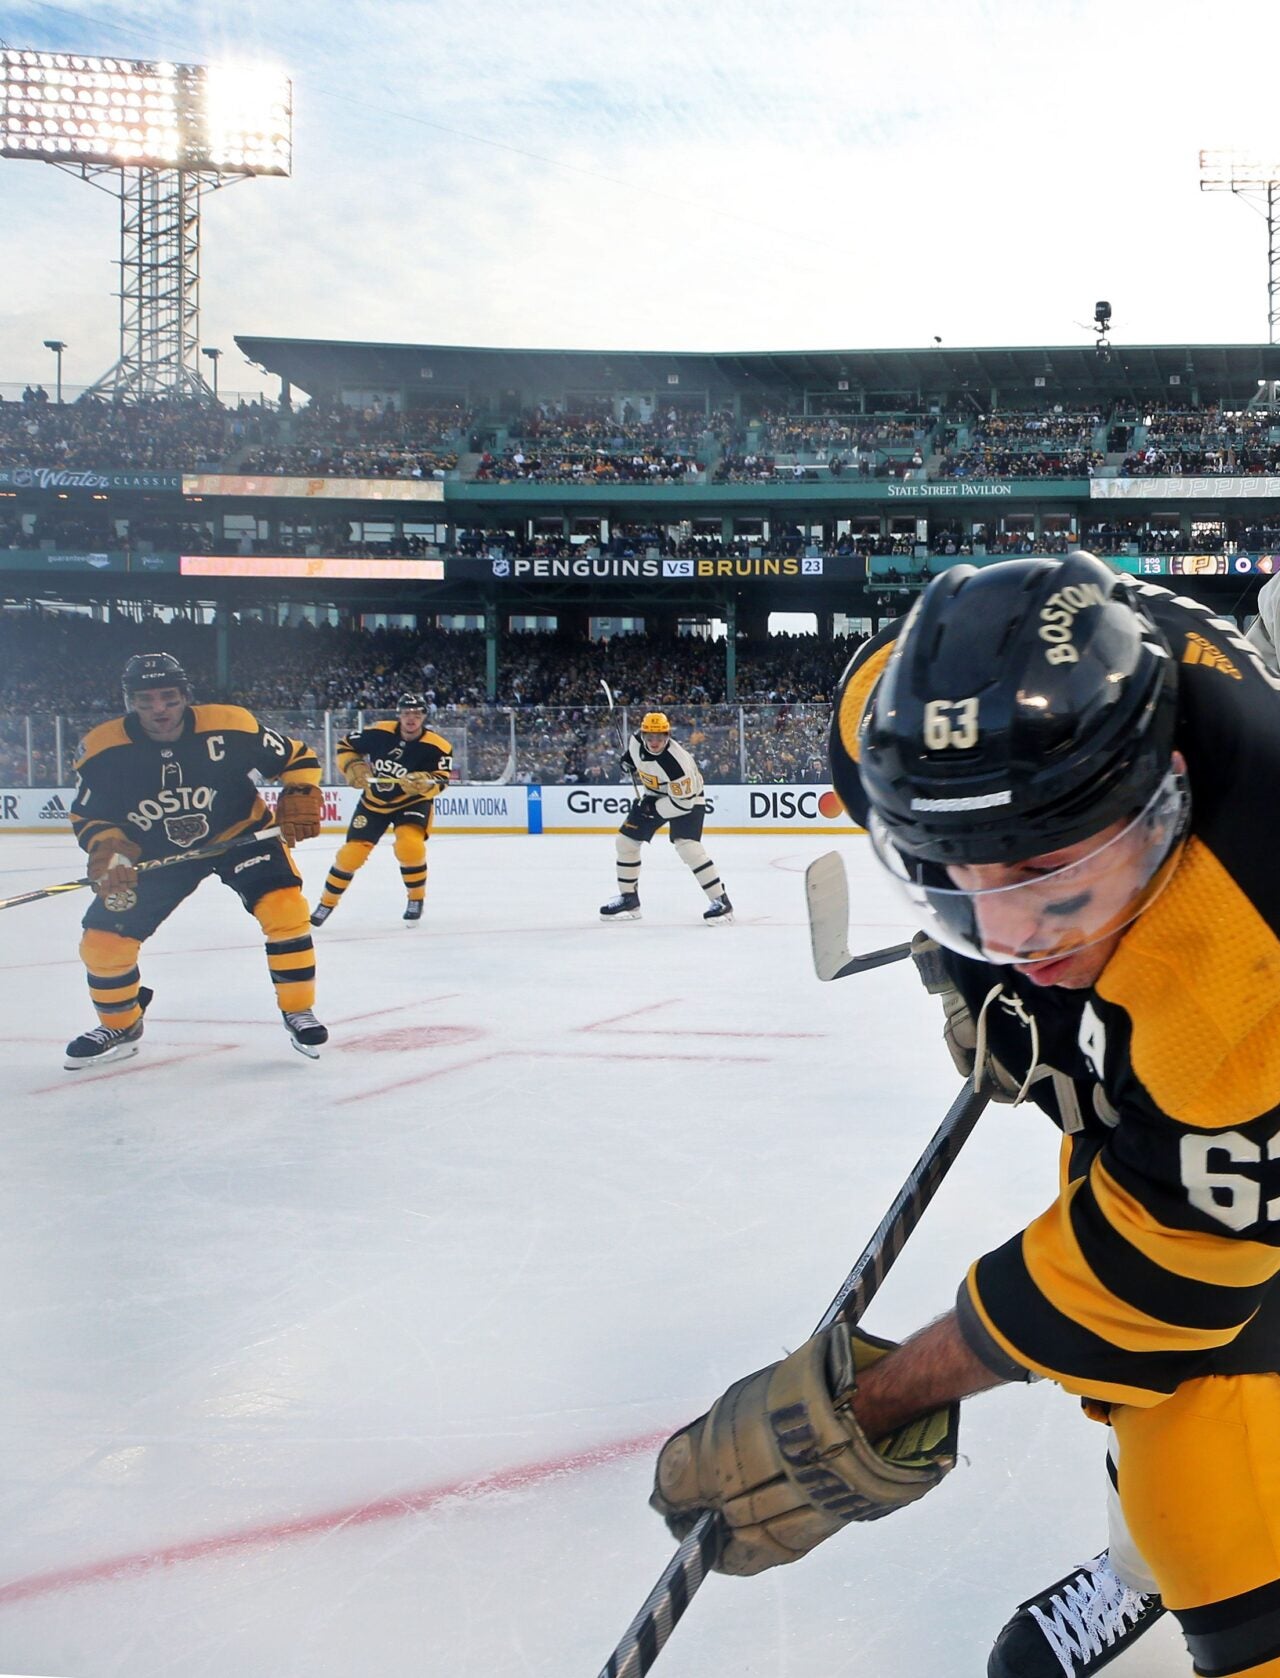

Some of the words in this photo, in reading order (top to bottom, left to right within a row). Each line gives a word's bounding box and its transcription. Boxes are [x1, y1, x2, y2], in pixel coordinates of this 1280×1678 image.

[34, 468, 109, 488] Winter
[114, 476, 178, 486] CLASSIC
[888, 484, 918, 496] STATE
[920, 484, 958, 496] STREET
[961, 483, 1012, 495] PAVILION
[513, 559, 659, 577] PENGUINS
[667, 562, 690, 575] VS
[698, 558, 799, 576] BRUINS
[804, 560, 821, 573] 23
[1144, 564, 1161, 574] 13
[1038, 583, 1105, 666] BOSTON
[923, 697, 980, 749] 63
[206, 735, 226, 762] C
[438, 756, 453, 771] 27
[472, 798, 508, 816] VODKA
[567, 790, 631, 814] Grea
[234, 853, 271, 874] CCM
